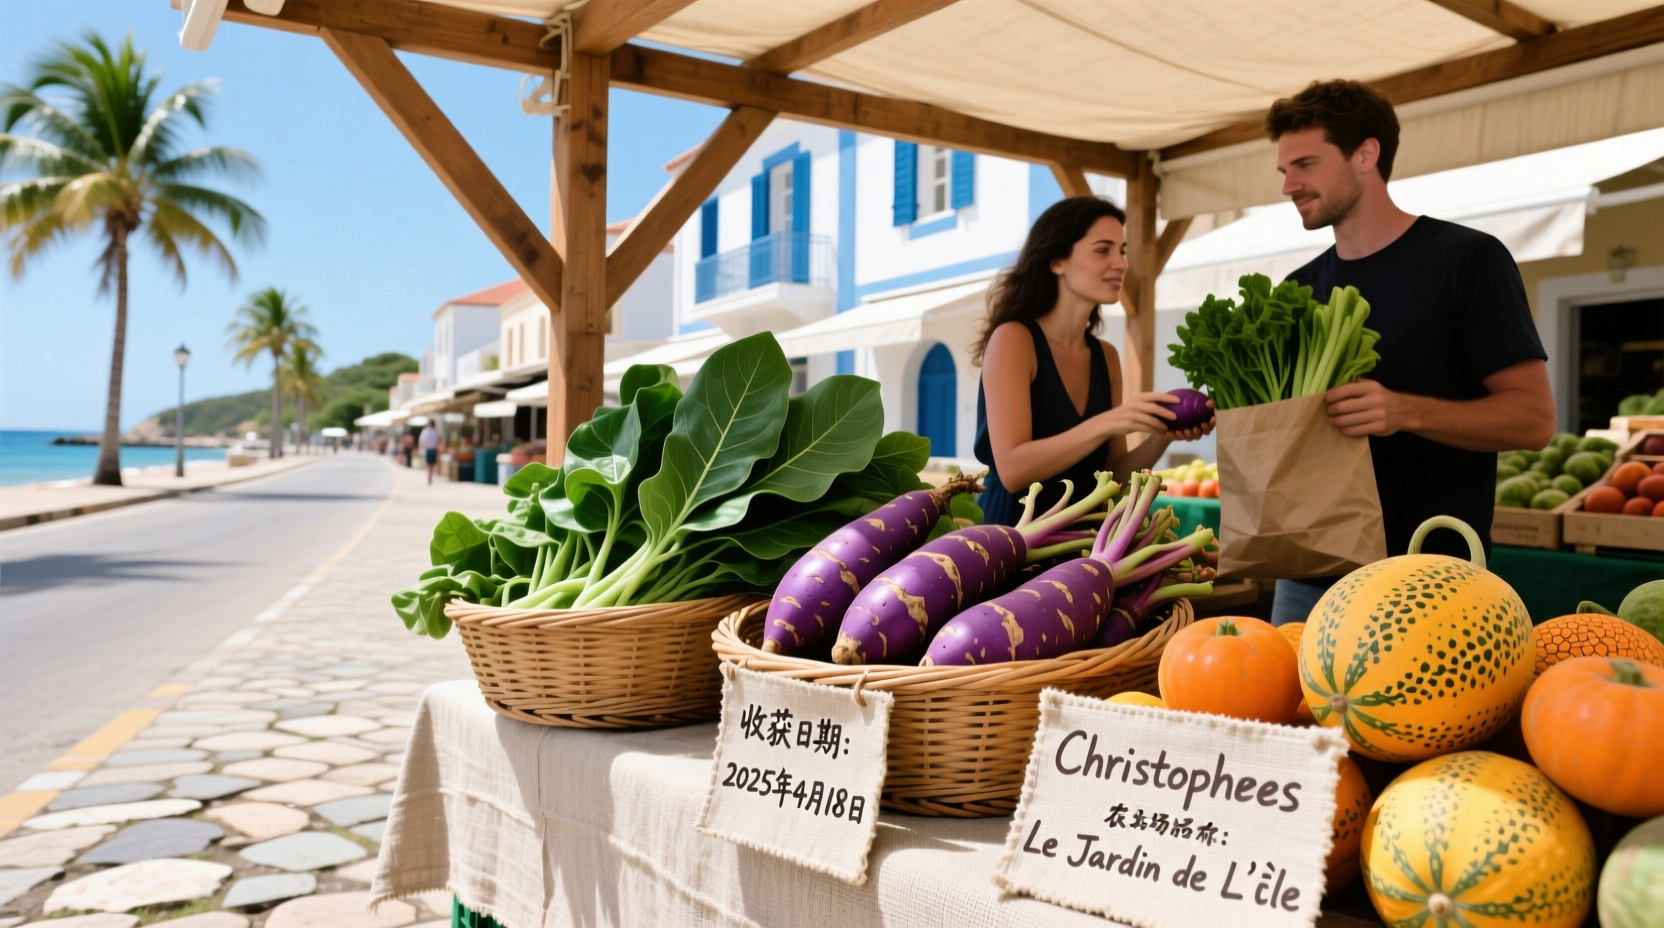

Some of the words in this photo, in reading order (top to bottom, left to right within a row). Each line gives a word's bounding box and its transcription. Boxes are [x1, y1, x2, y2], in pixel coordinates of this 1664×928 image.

[740, 704, 850, 759] 收获日期:
[722, 762, 866, 824] 2025年4月18日
[1055, 730, 1302, 812] Christophees
[1023, 819, 1059, 857] Le
[1067, 833, 1161, 882] Jardin
[1172, 854, 1208, 892] de
